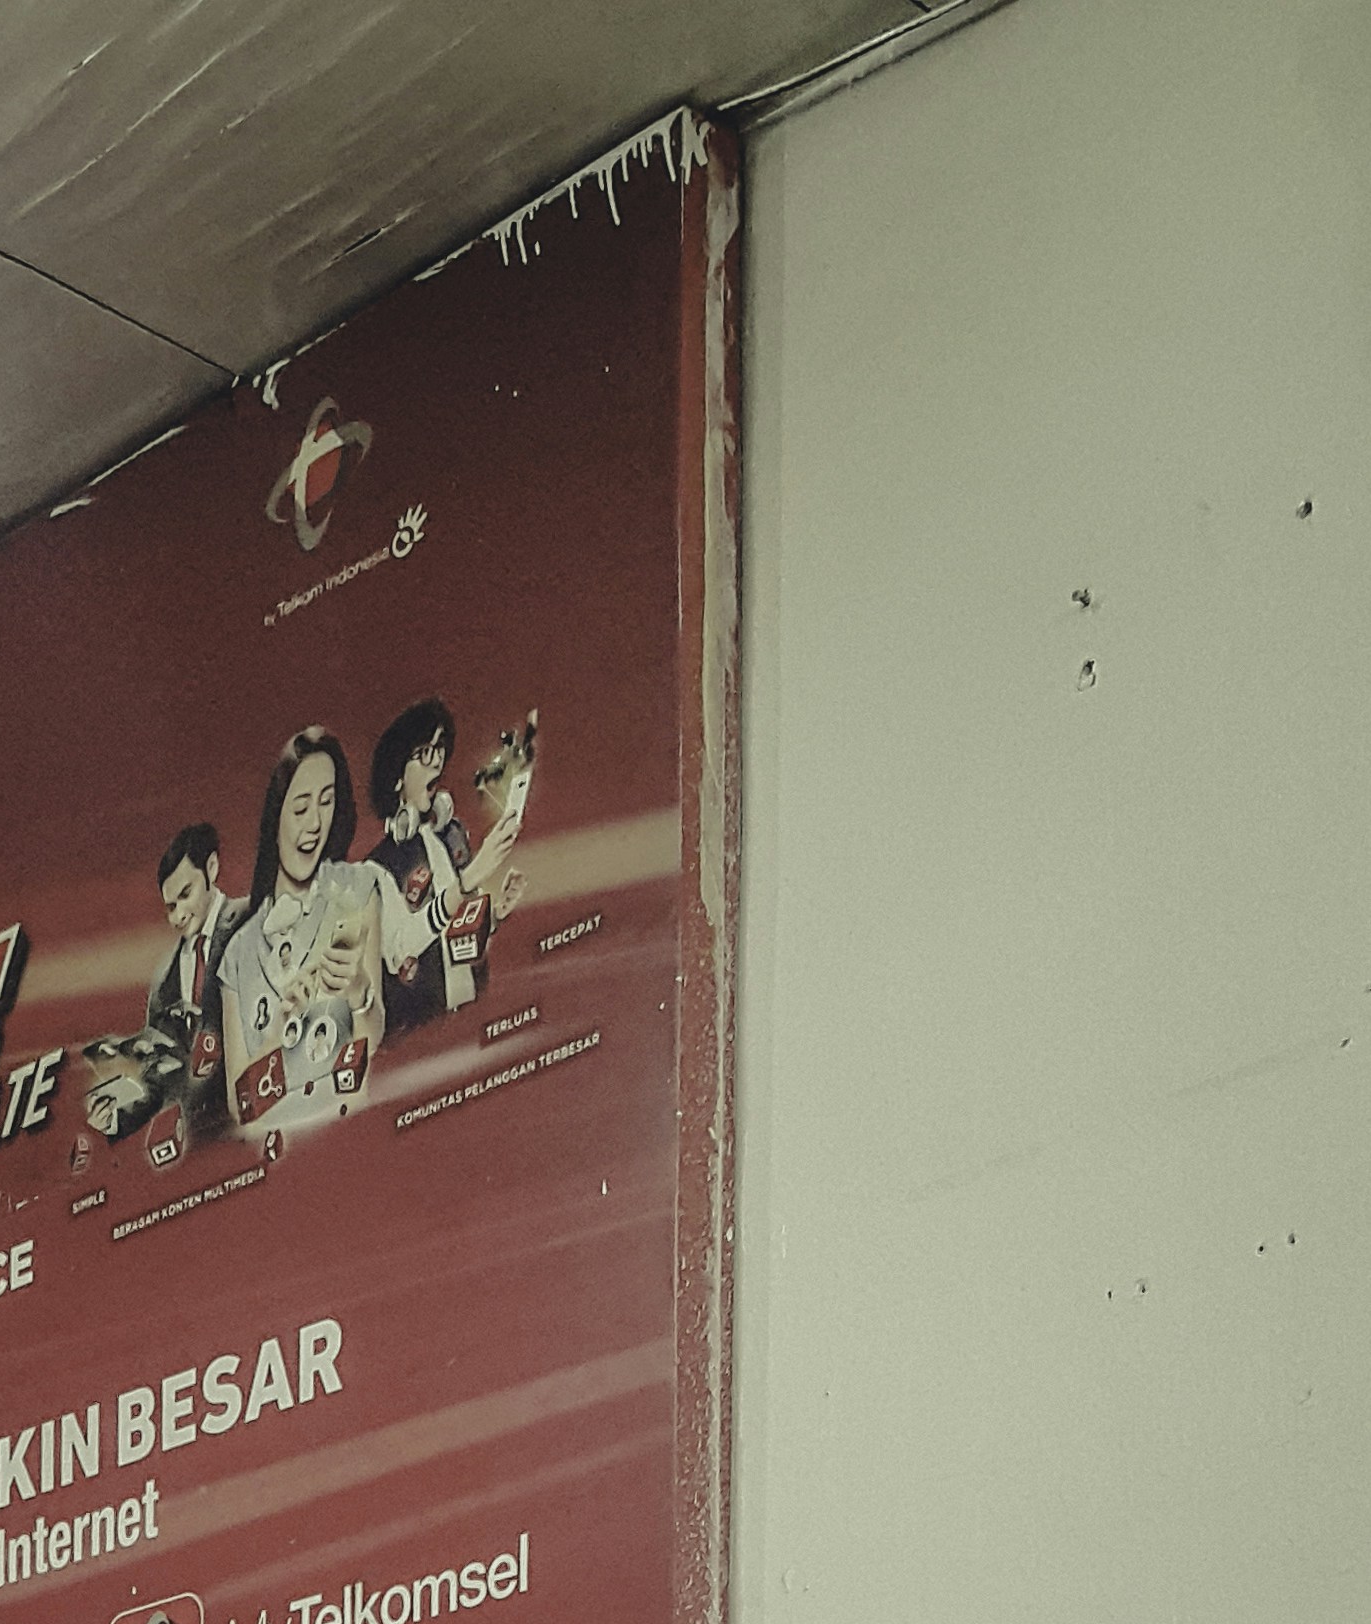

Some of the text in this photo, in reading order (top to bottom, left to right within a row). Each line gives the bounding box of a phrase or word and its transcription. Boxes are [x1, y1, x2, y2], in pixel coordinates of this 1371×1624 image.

[539, 914, 602, 952] TERCEPAT
[485, 1006, 539, 1040] TERLUAS
[396, 1031, 601, 1128] KOMUNITAS PELANGGAN TERBESAR
[72, 1190, 106, 1215] SIMPLE
[161, 1194, 203, 1220] KONTEN
[203, 1167, 266, 1202] MULTIMEDIA
[117, 1317, 343, 1468] BESAR
